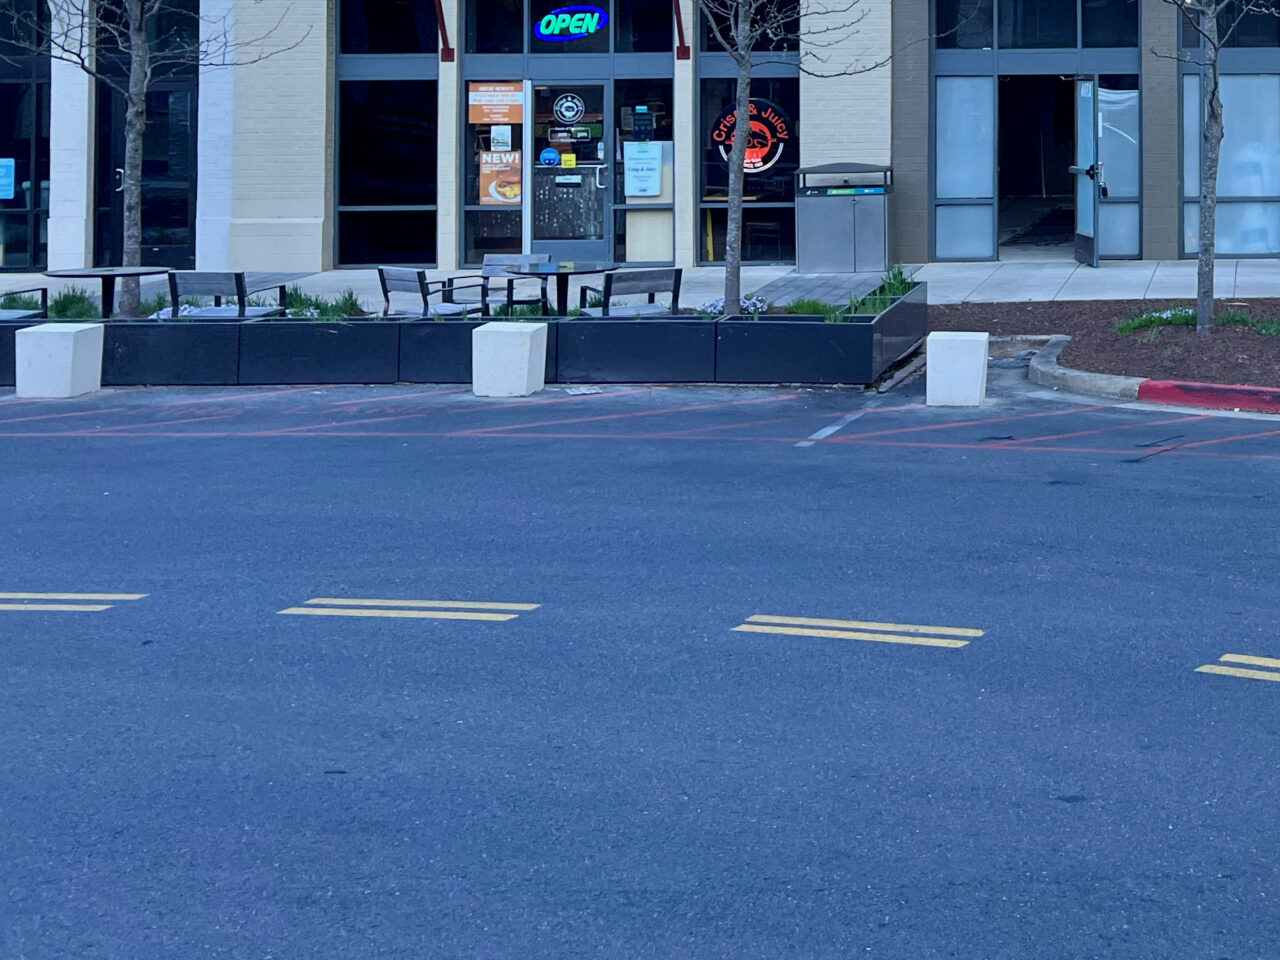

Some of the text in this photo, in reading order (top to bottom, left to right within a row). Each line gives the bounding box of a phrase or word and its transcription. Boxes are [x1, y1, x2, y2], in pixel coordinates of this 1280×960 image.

[540, 12, 600, 35] OPEN
[713, 103, 789, 141] Cris & Juicy
[482, 153, 520, 163] NEW!
